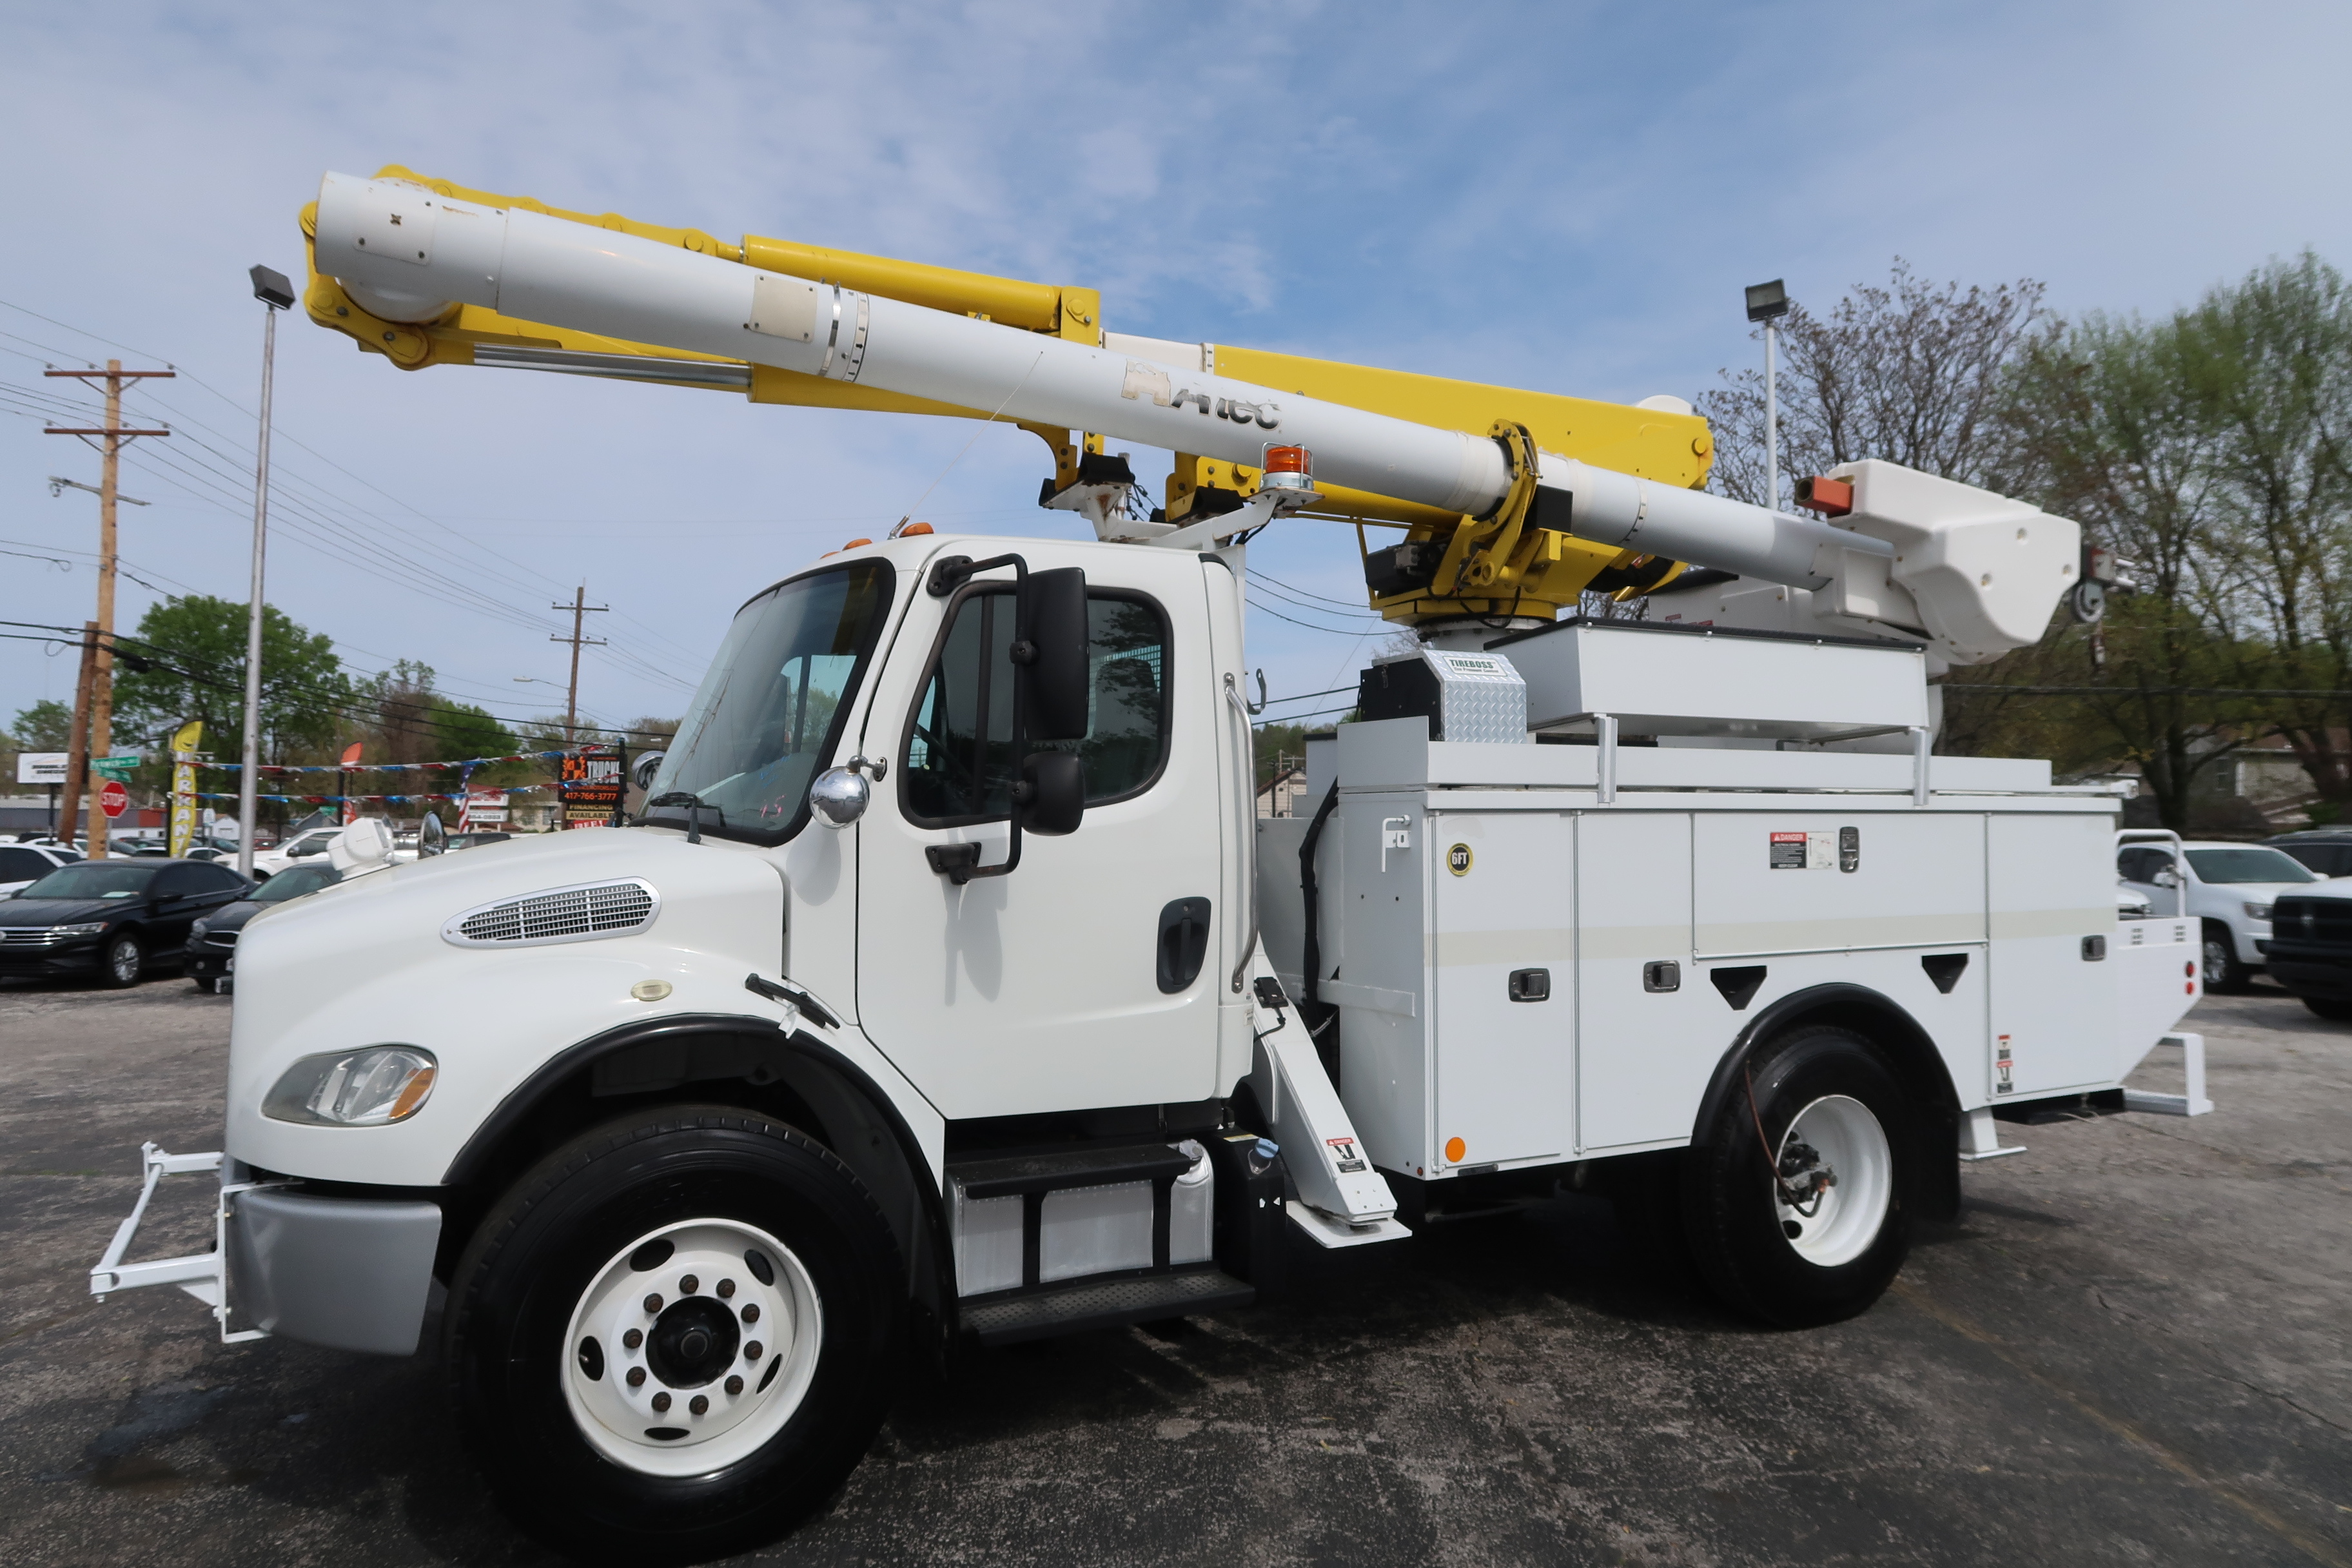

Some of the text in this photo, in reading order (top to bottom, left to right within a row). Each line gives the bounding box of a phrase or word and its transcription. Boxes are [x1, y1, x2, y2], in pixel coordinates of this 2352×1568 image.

[1449, 660, 1494, 669] TIREBOSS
[102, 792, 126, 807] STOP
[1451, 852, 1467, 865] 6FT
